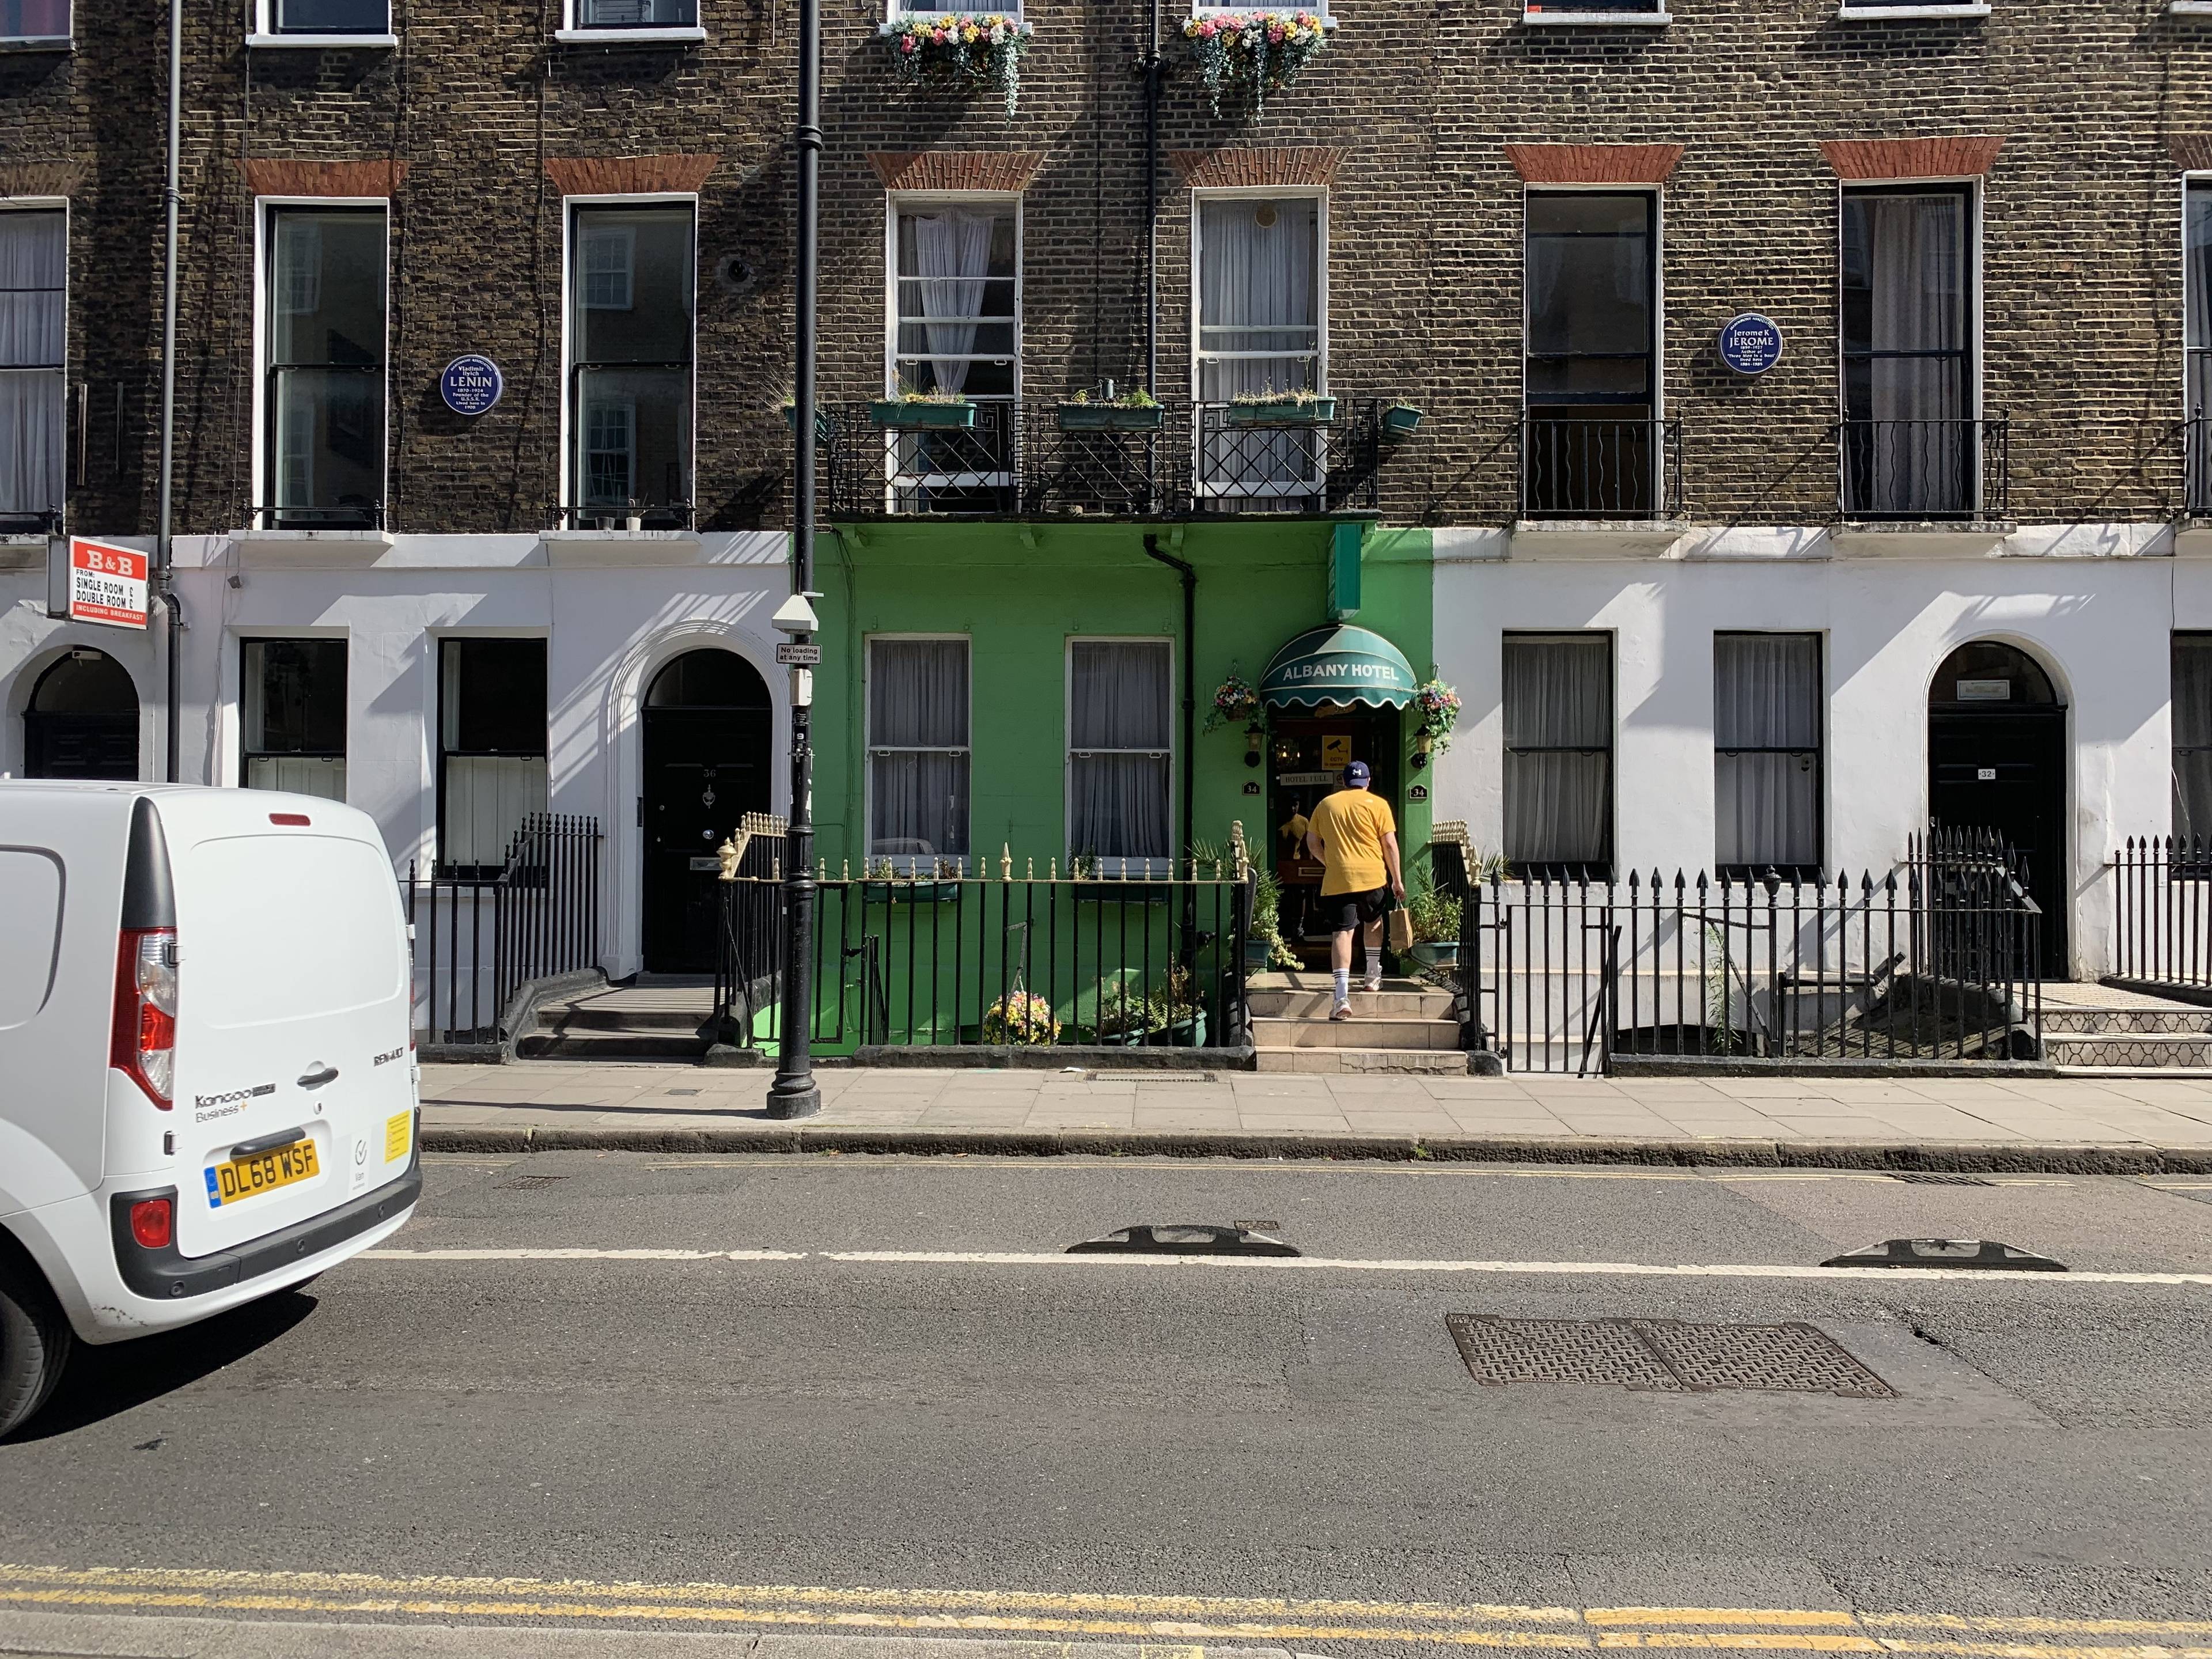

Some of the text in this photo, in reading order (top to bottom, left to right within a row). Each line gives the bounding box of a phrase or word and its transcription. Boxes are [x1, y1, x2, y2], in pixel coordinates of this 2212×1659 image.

[1729, 338, 1774, 348] JEROME
[450, 376, 493, 387] LENIN
[76, 569, 95, 578] FROM:
[76, 577, 101, 592] SINGLE
[104, 582, 123, 596] ROOM
[76, 590, 104, 604] DOUBLE
[107, 595, 126, 608] ROOM
[76, 604, 143, 621] INCLUDING BREAKFAST
[1283, 664, 1399, 681] ALBANY HOTEL
[703, 769, 716, 778] 36
[1310, 774, 1328, 782] FULL
[373, 1046, 404, 1067] RENAULT
[195, 1089, 252, 1109] Kangoo
[221, 1144, 313, 1198] DL68 WSF
